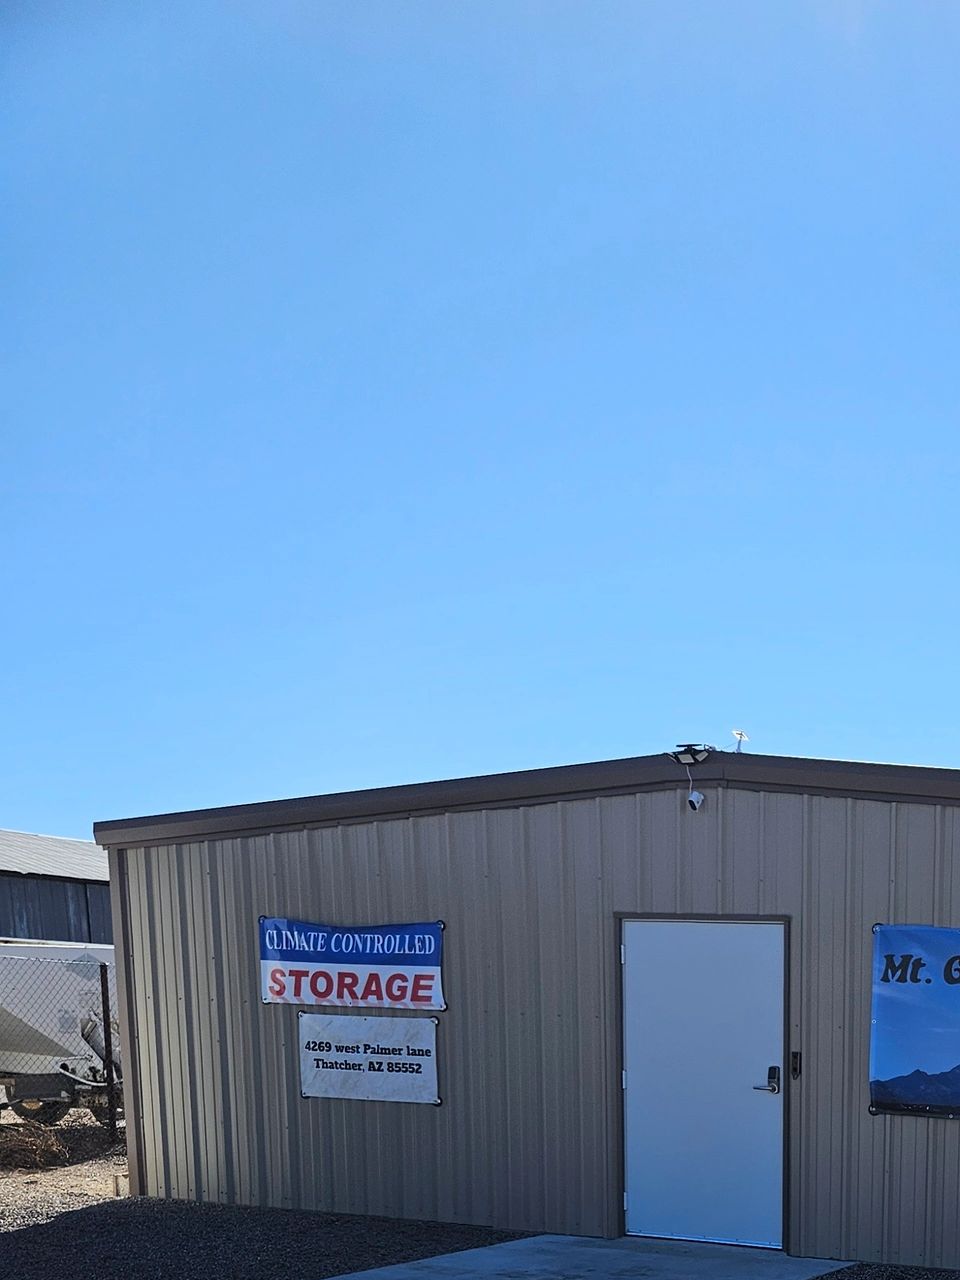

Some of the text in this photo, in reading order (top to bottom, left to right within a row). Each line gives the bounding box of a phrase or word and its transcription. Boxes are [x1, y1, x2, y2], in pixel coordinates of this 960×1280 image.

[265, 929, 435, 955] CLIMATE CONTROLLED
[880, 953, 932, 984] Mt.
[268, 968, 436, 1003] STORAGE
[304, 1040, 432, 1057] 4269 west Palmer lane
[313, 1058, 423, 1074] Thatcher, AZ 85552
